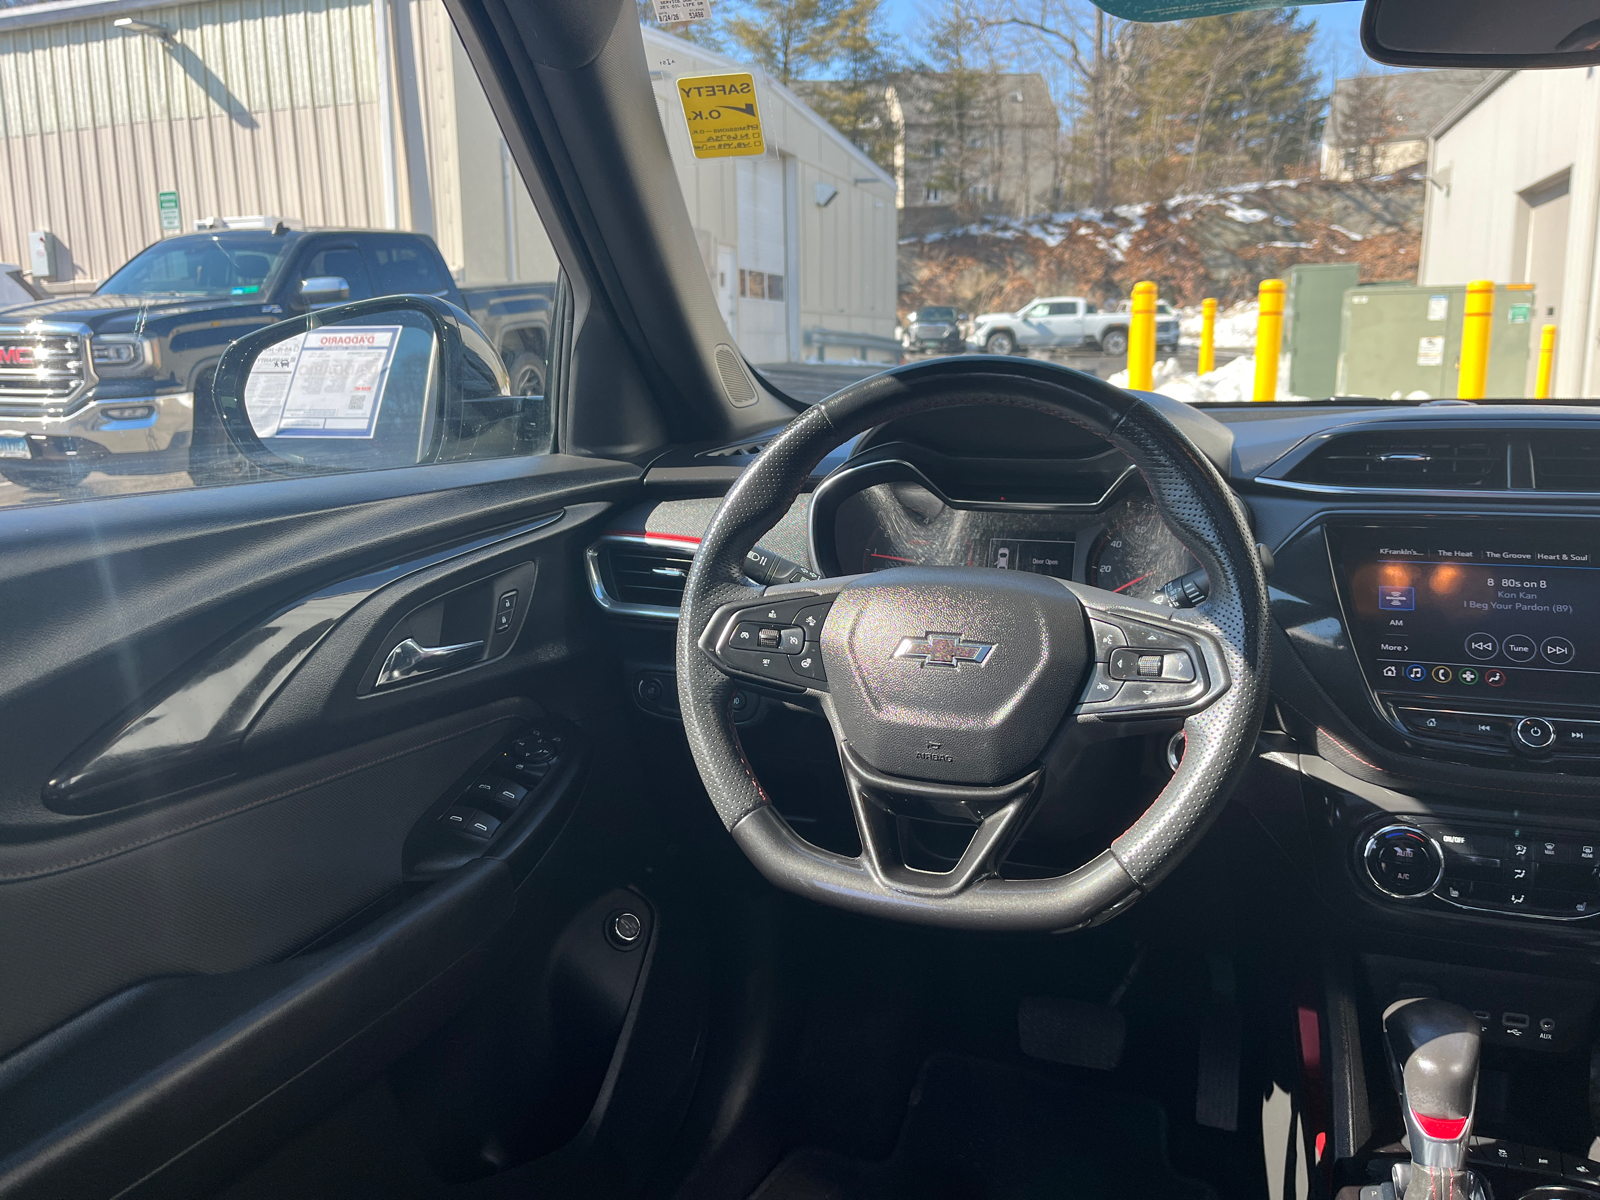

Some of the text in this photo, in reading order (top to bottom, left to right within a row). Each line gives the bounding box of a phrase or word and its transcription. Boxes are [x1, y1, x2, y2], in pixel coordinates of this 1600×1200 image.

[1487, 578, 1494, 586] 8
[1502, 579, 1521, 587] 80s
[1539, 580, 1547, 588] 8
[1469, 601, 1488, 610] Beg
[1515, 603, 1549, 611] Pardon
[1552, 604, 1572, 613] (89)
[916, 752, 954, 763] AIRBAG
[1443, 835, 1466, 843] ON/OFF
